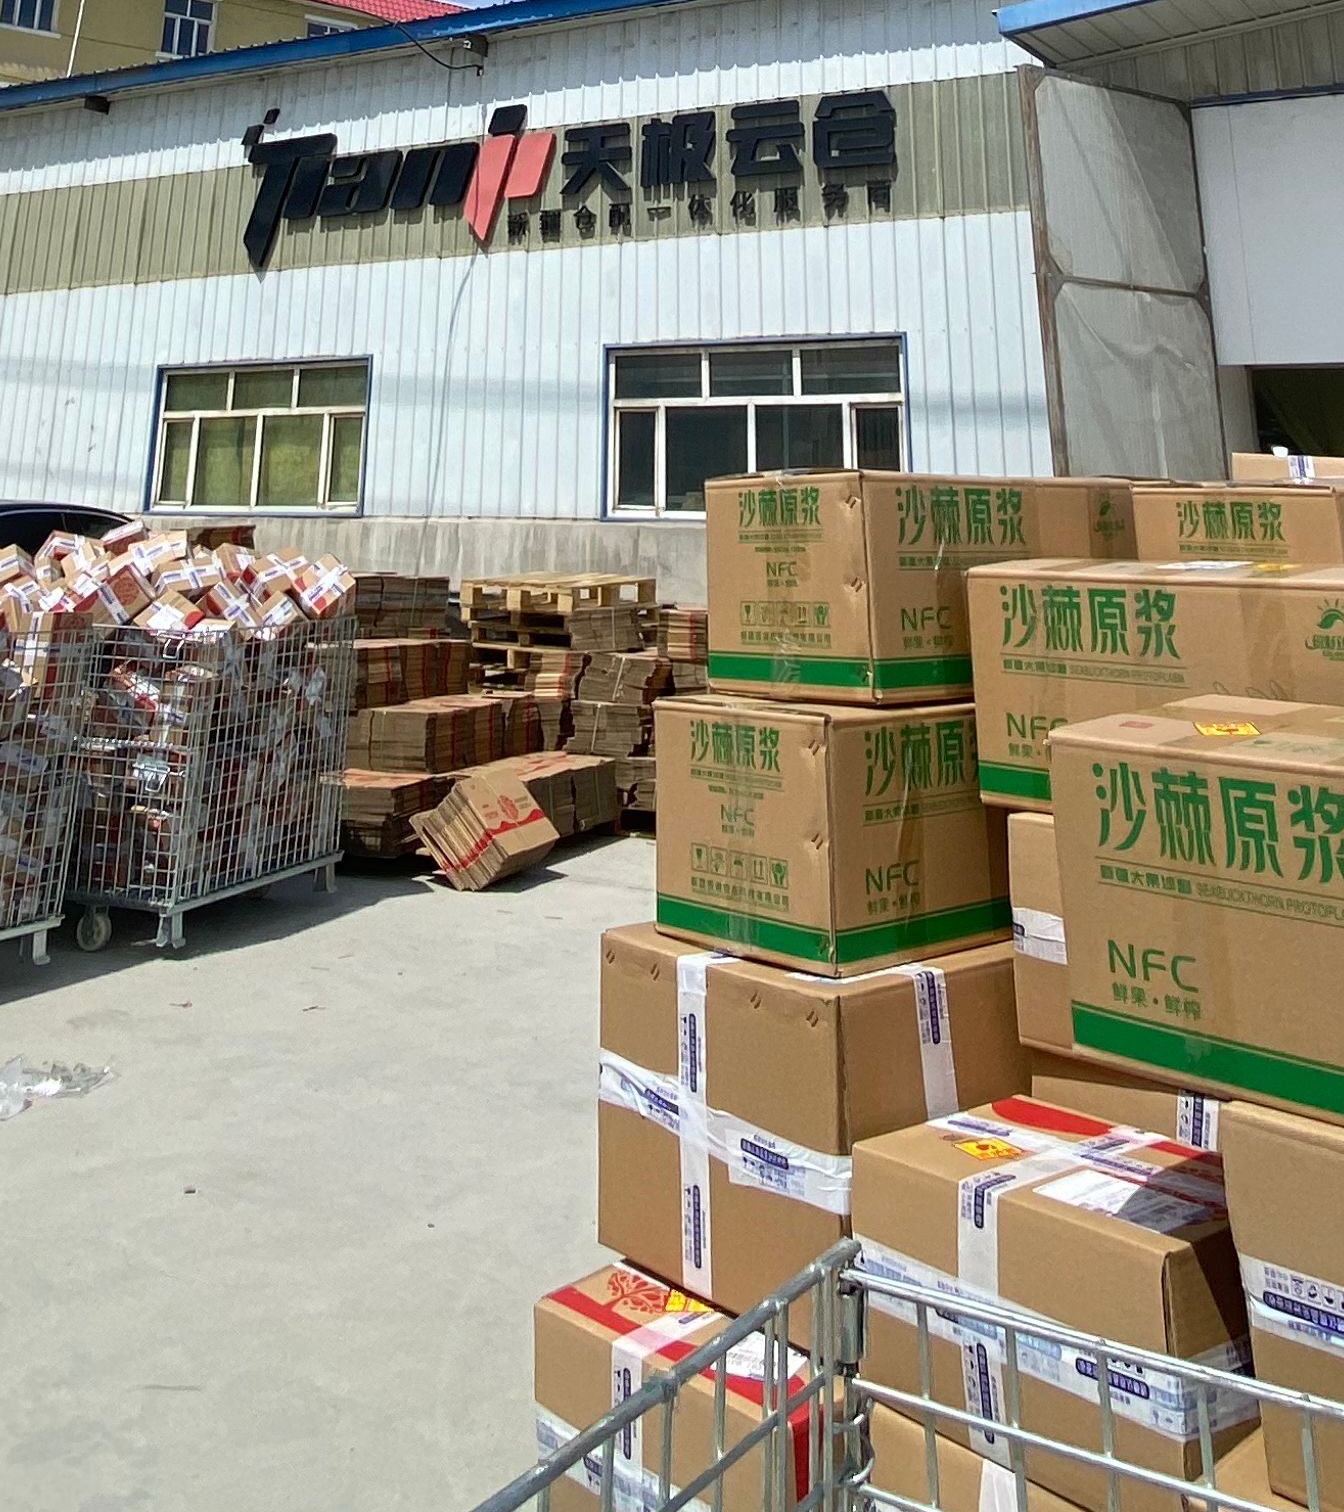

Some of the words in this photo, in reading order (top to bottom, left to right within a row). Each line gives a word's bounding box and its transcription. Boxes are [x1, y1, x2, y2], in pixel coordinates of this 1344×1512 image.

[560, 89, 897, 194] 天极云仓
[738, 486, 822, 528] 沙棘原浆
[895, 485, 1026, 545] 沙棘原浆
[1175, 500, 1286, 542] 沙棘原浆
[766, 561, 799, 578] NFC
[900, 606, 953, 633] NFC
[1000, 583, 1181, 660] 沙棘原浆
[690, 719, 782, 774] 沙棘原浆
[864, 717, 979, 798] 沙棘原
[721, 804, 755, 827] NFC
[865, 859, 921, 896] NFC
[1107, 939, 1199, 994] NFC
